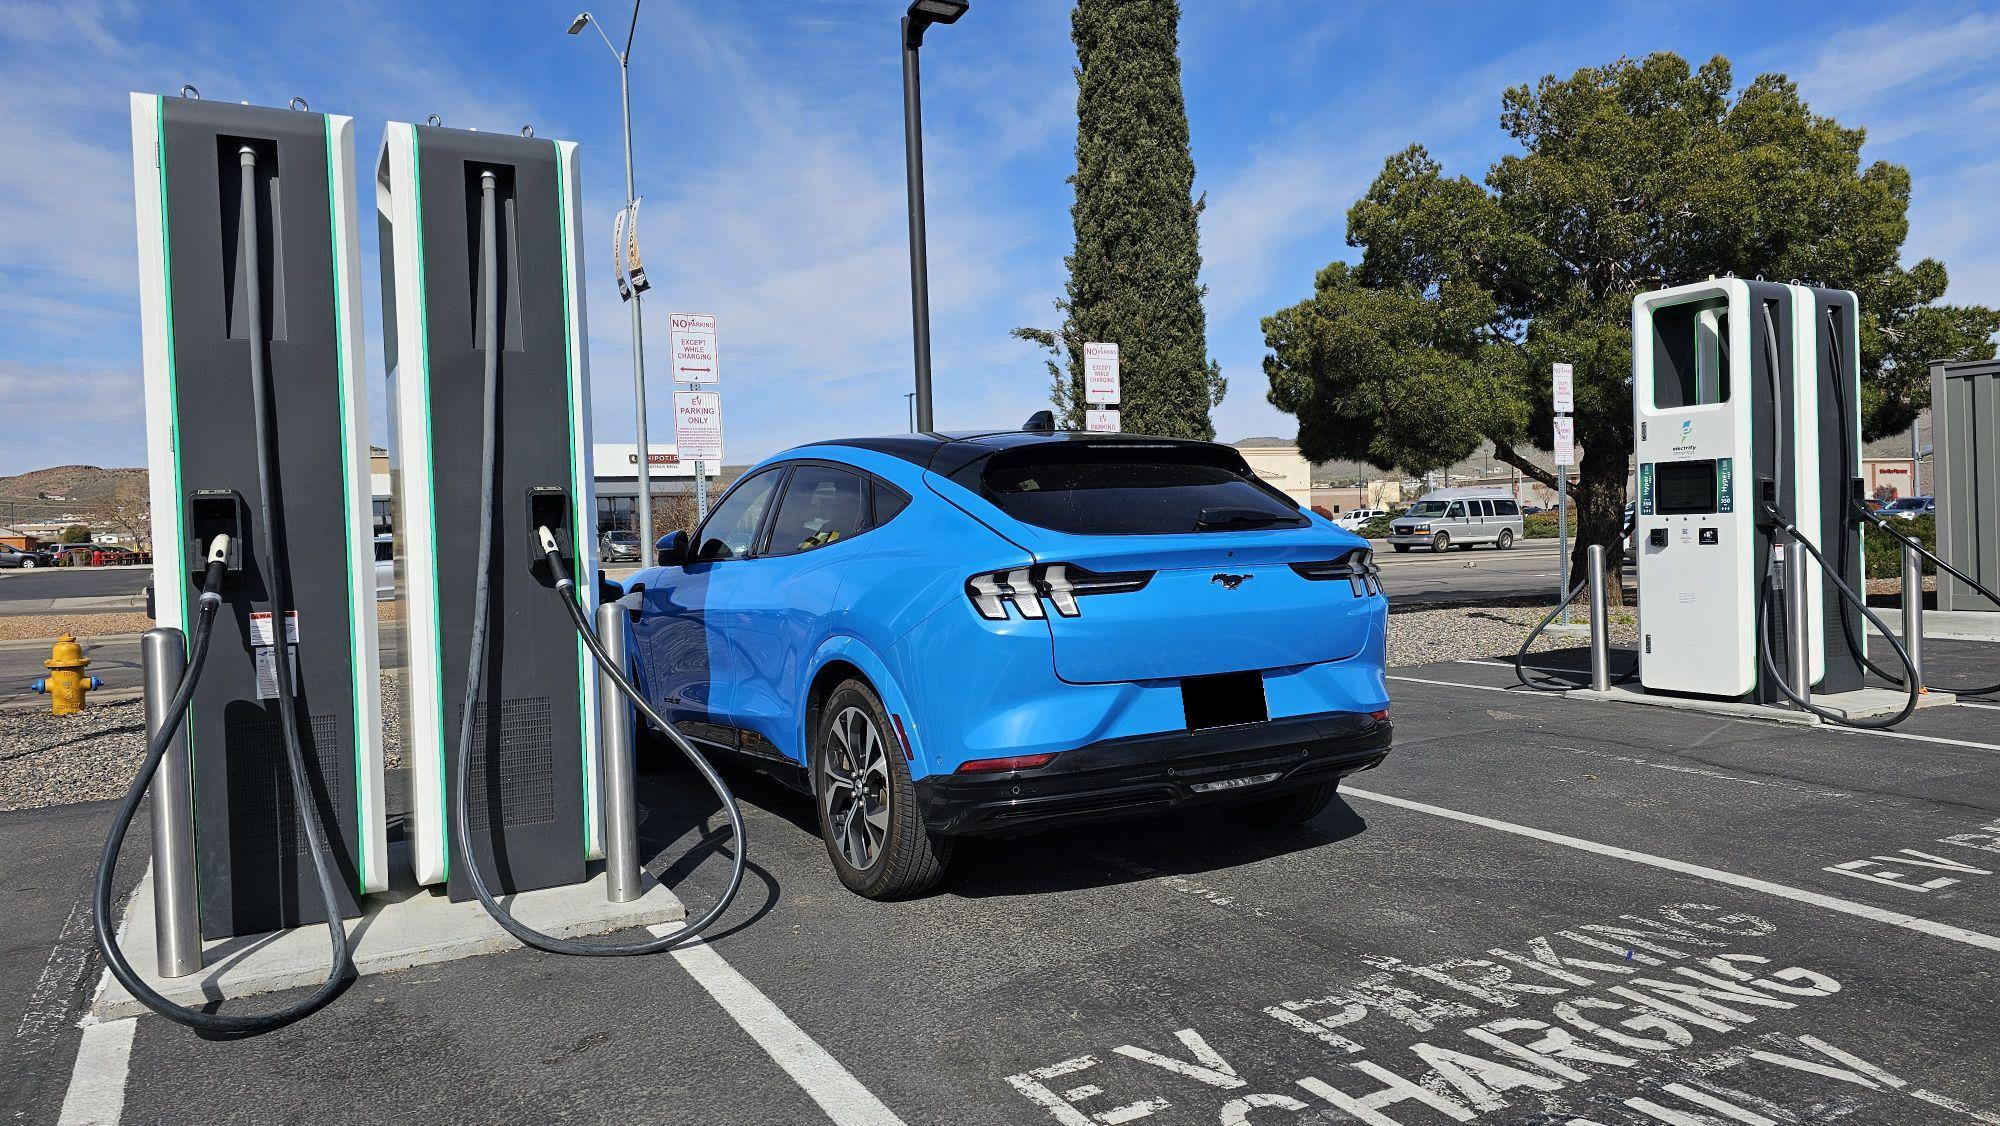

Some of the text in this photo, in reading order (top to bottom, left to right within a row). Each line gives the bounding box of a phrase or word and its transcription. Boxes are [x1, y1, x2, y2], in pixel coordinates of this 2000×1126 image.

[672, 319, 687, 328] NO
[1087, 348, 1097, 356] NO
[692, 398, 702, 406] EV
[1822, 849, 1994, 892] EV
[1003, 902, 1778, 1126] EV PARKING
